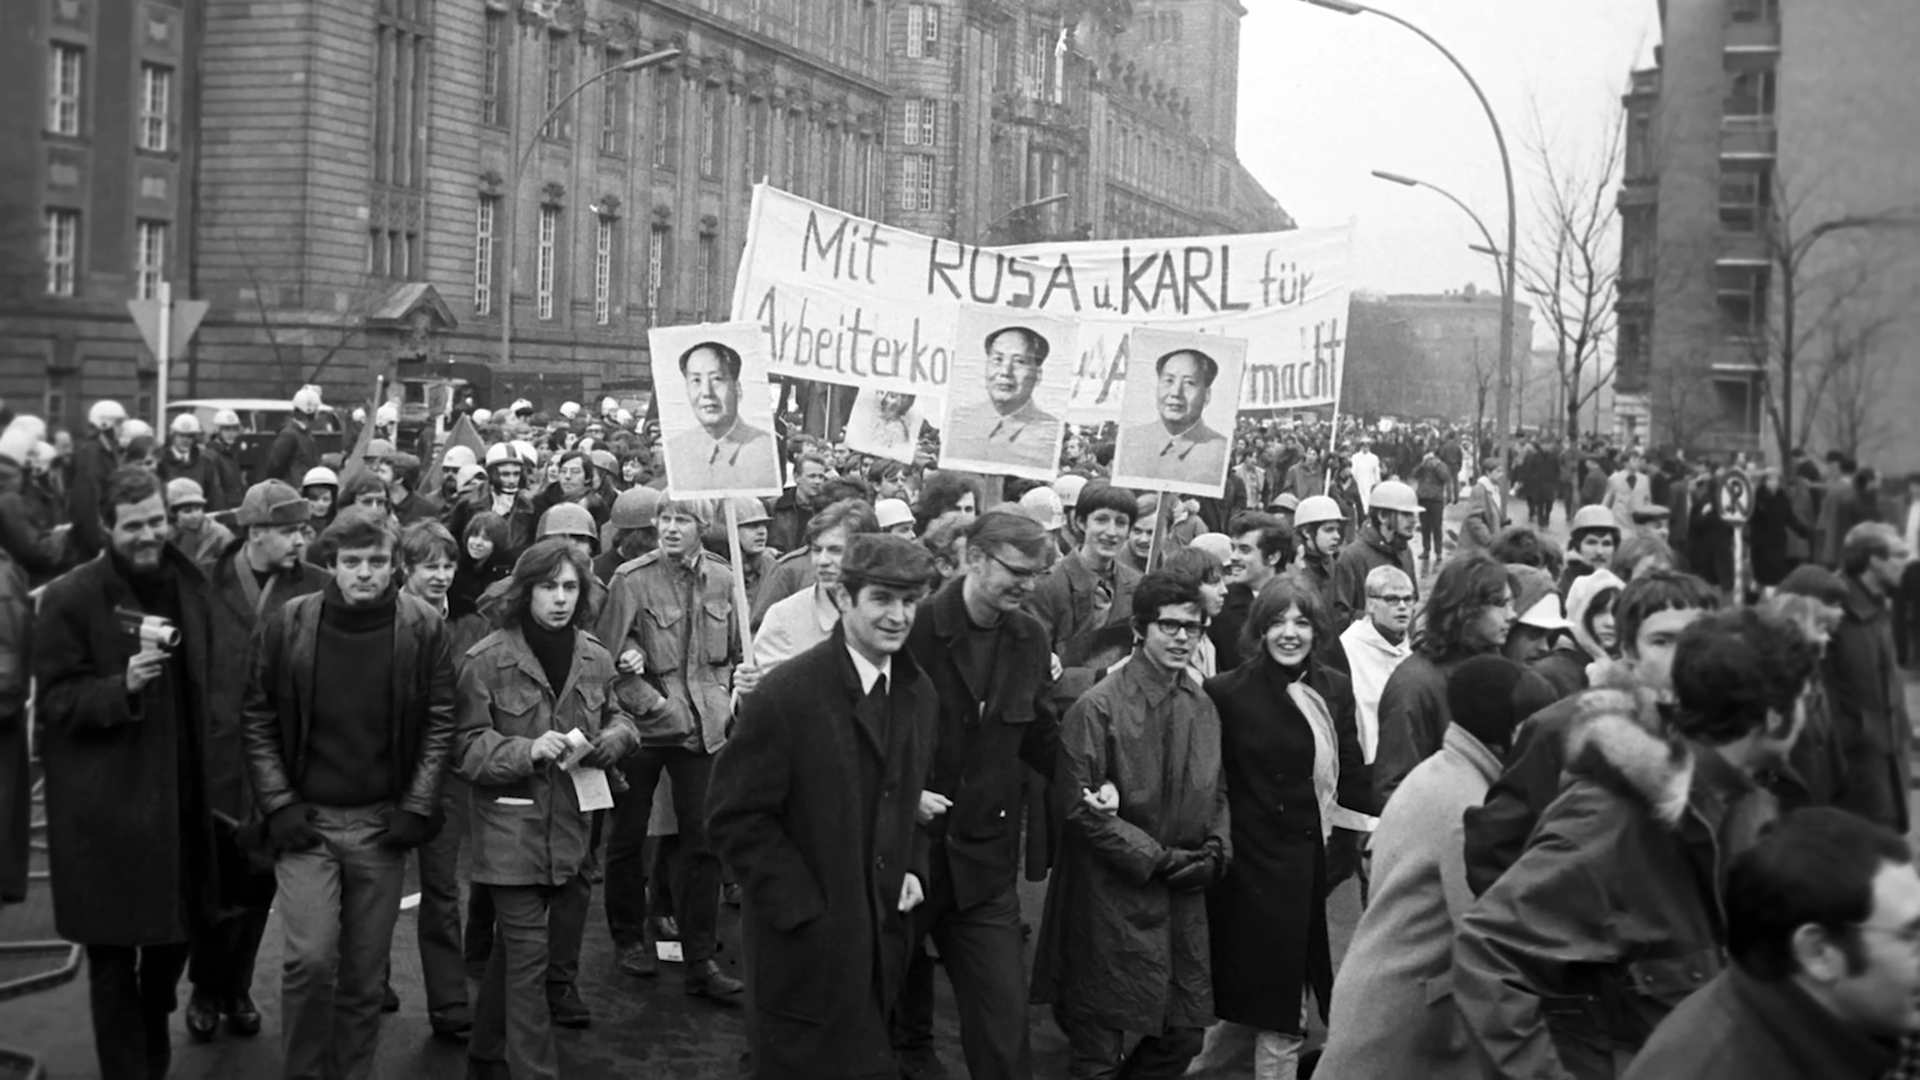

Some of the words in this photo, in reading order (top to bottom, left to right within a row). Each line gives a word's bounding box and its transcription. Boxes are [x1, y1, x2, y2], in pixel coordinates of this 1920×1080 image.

[801, 209, 889, 284] Mit
[1121, 244, 1252, 315] KARL
[1259, 248, 1315, 307] für
[756, 285, 955, 385] Arbeiterko
[1243, 317, 1341, 405] macht
